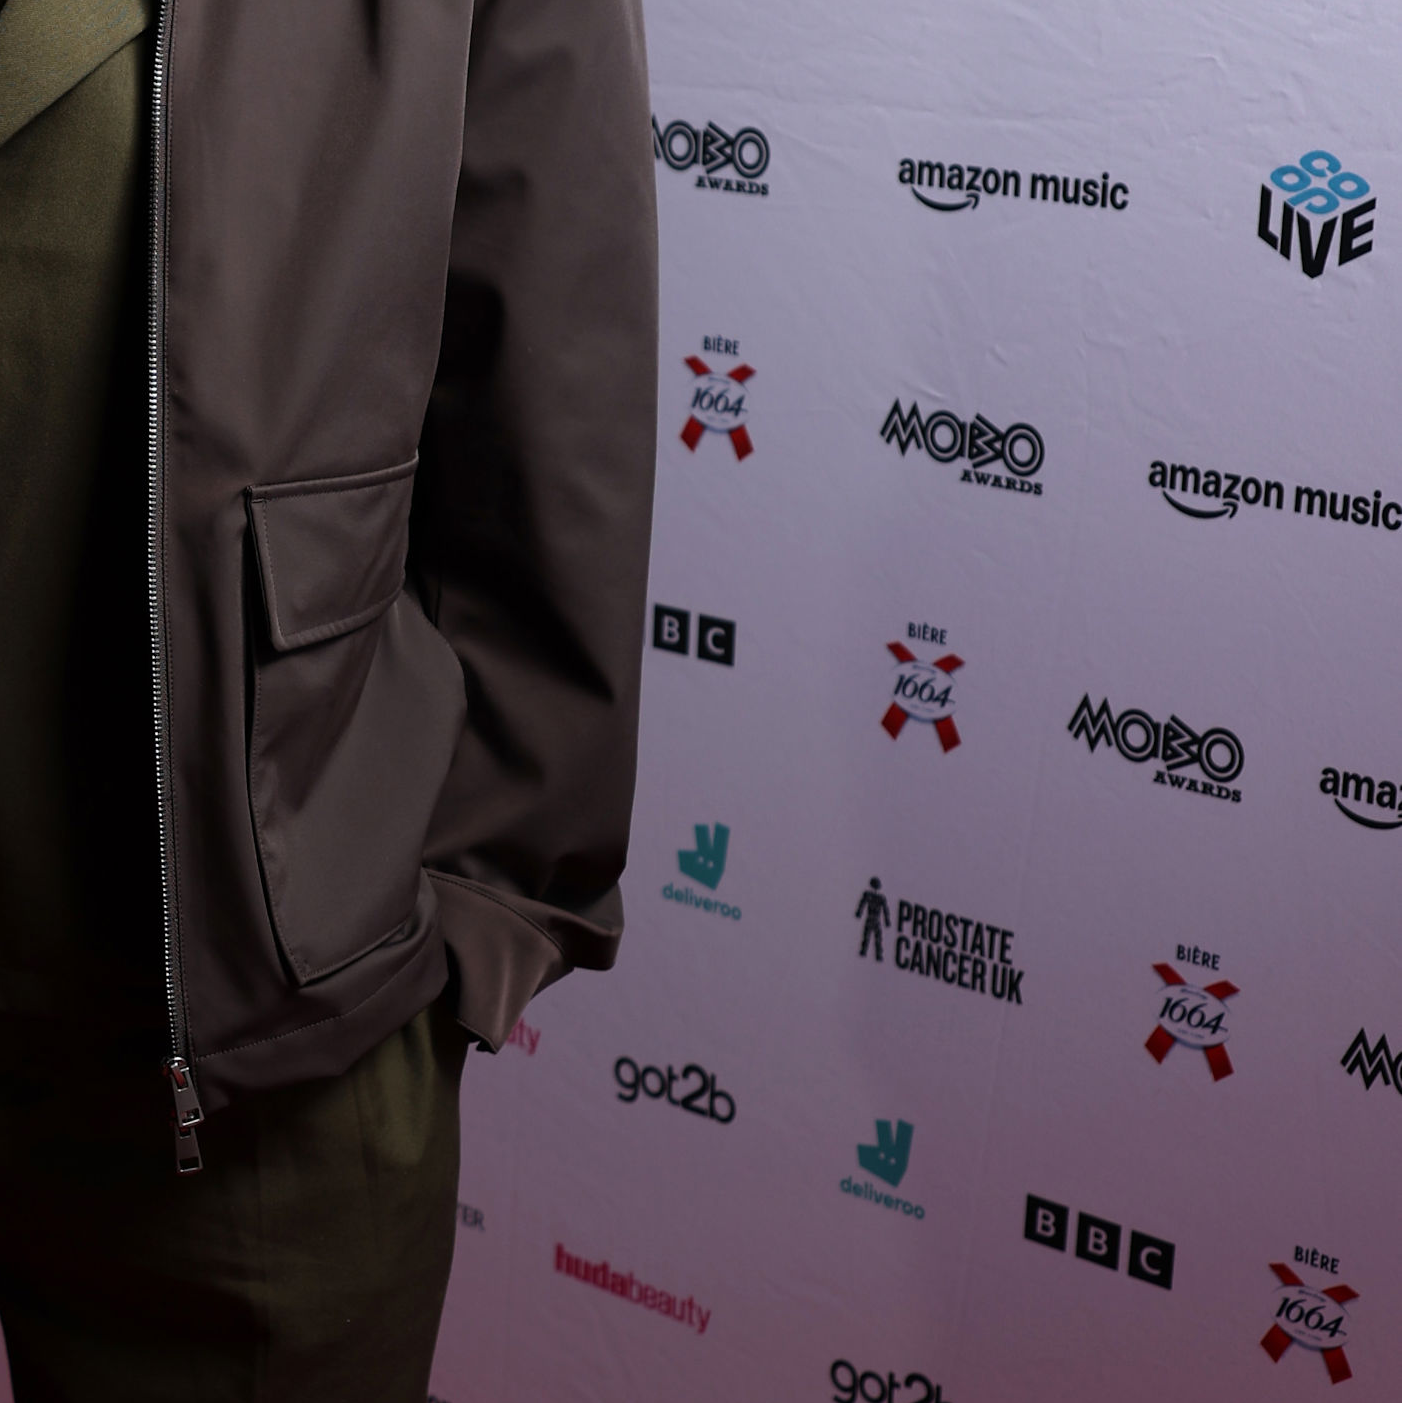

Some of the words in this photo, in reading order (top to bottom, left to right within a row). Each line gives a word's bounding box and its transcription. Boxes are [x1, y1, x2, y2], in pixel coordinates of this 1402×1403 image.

[694, 174, 770, 197] AWARDS
[898, 157, 1021, 202] amazon
[1029, 169, 1129, 212] music
[1257, 182, 1377, 280] LIVE
[703, 334, 740, 357] BIÈRE
[691, 385, 748, 417] 1664
[880, 398, 1045, 479] MOBO
[959, 467, 1044, 496] AWARDS
[1148, 459, 1285, 512] amazon
[1293, 484, 1402, 532] music
[906, 620, 948, 646] BIÈRE
[892, 670, 955, 711] 1664
[1068, 693, 1245, 785] MOBO
[1152, 768, 1243, 804] AWARDS
[897, 898, 1015, 966] PROSTATE
[894, 934, 987, 995] CANCER
[990, 962, 1026, 1006] UK
[1175, 944, 1221, 972] BIÈRE
[1158, 996, 1230, 1036] 1664
[613, 1055, 737, 1126] got2b
[838, 1173, 926, 1223] deliveroo
[1028, 1198, 1172, 1286] BBC
[1292, 1244, 1341, 1276] BIÈRE
[553, 1241, 714, 1336] hudabeauty
[1273, 1293, 1348, 1342] 1664
